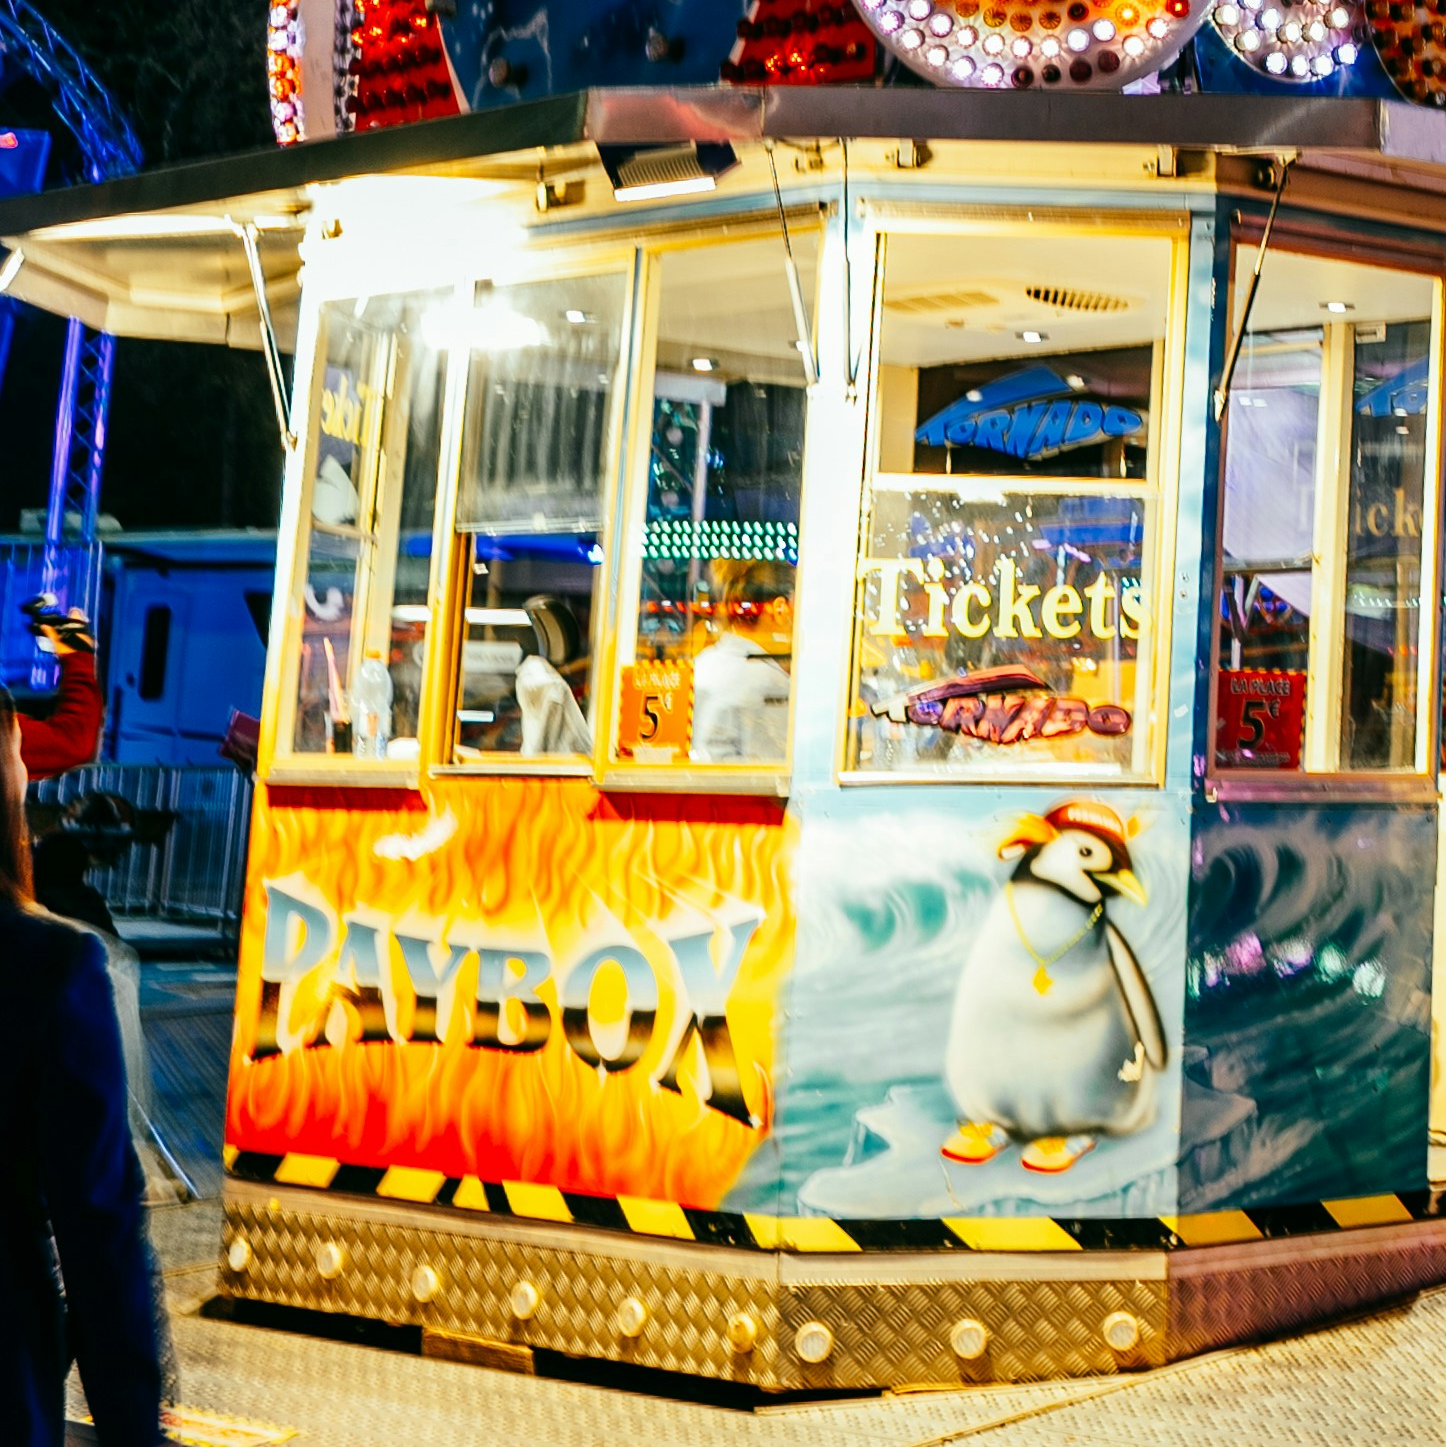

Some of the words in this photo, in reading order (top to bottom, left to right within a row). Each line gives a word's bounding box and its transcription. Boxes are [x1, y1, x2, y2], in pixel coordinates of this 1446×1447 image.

[915, 366, 1143, 461] TORNADO
[857, 555, 1152, 640] Tickets
[1231, 676, 1248, 695] LA
[1250, 677, 1291, 696] PLACE
[244, 882, 766, 1129] PAYBOX
